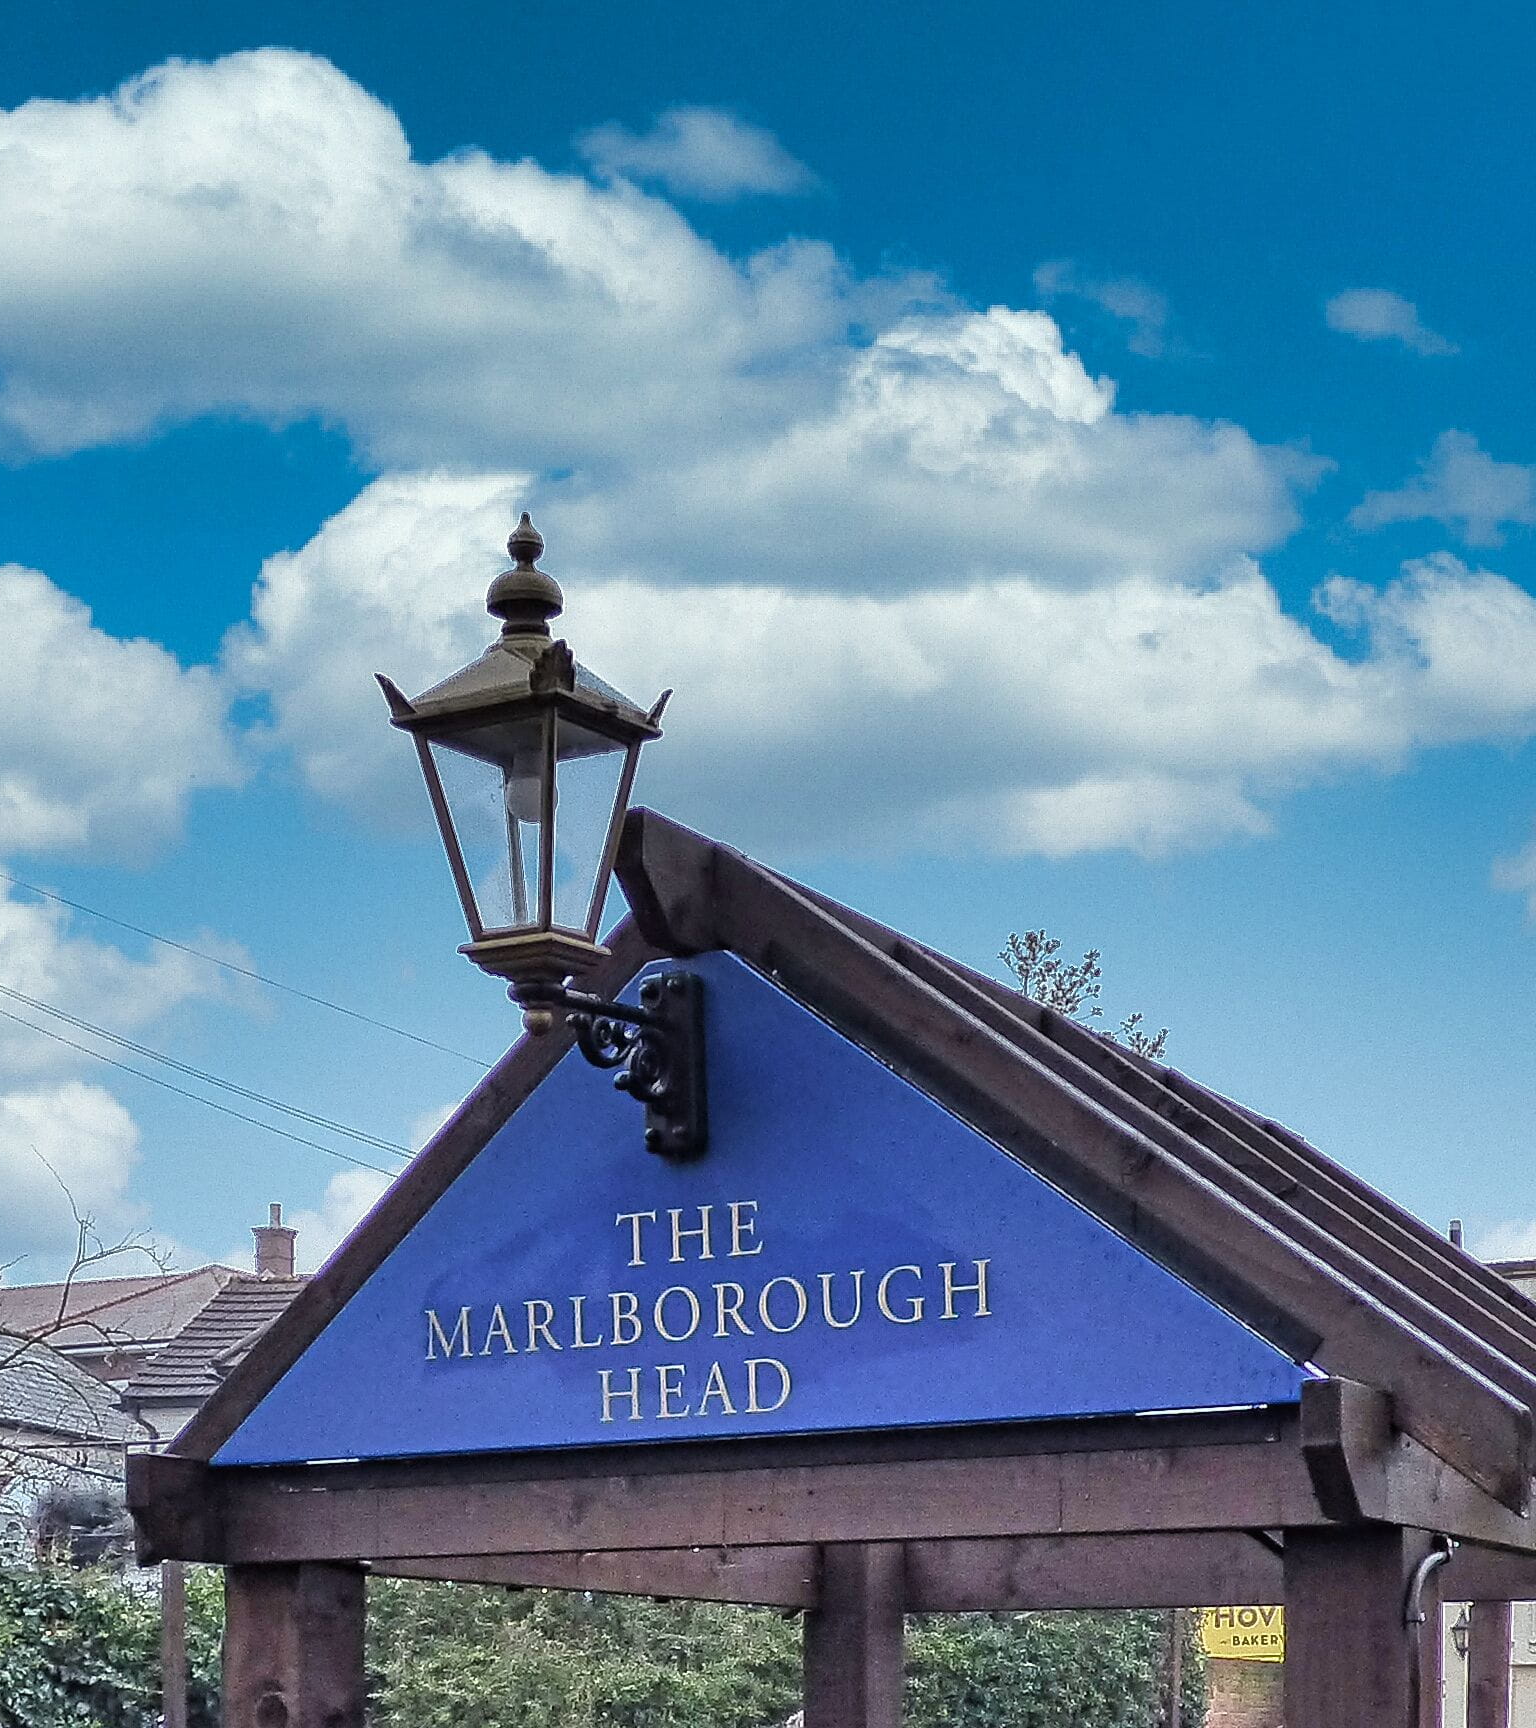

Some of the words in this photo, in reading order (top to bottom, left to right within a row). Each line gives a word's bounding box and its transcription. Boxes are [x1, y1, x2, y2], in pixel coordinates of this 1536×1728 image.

[615, 1200, 763, 1267] THE
[424, 1258, 992, 1361] MARLBOROUGH
[598, 1357, 792, 1423] HEAD
